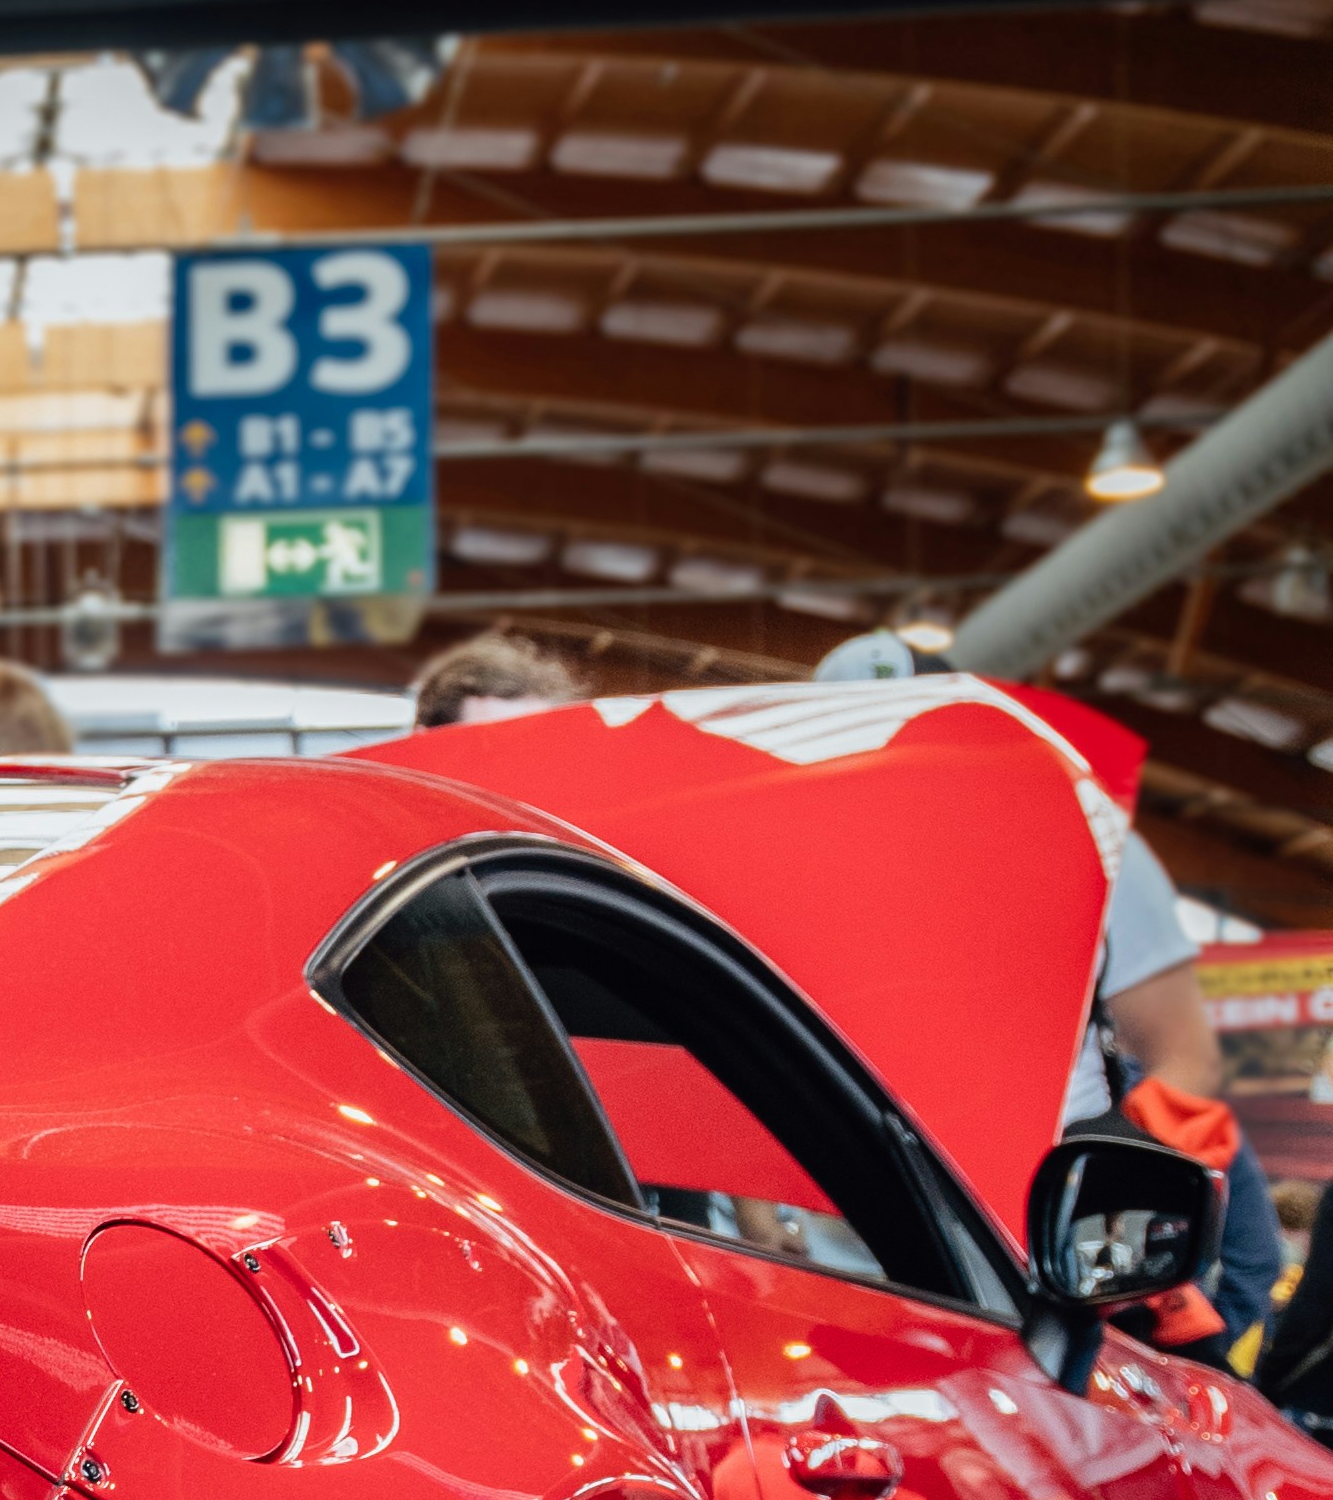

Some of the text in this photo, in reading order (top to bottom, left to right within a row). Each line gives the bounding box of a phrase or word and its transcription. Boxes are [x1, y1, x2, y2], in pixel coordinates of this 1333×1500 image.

[187, 250, 411, 399] B3
[238, 412, 301, 458] B1
[235, 463, 301, 503] A1
[342, 455, 416, 500] A7
